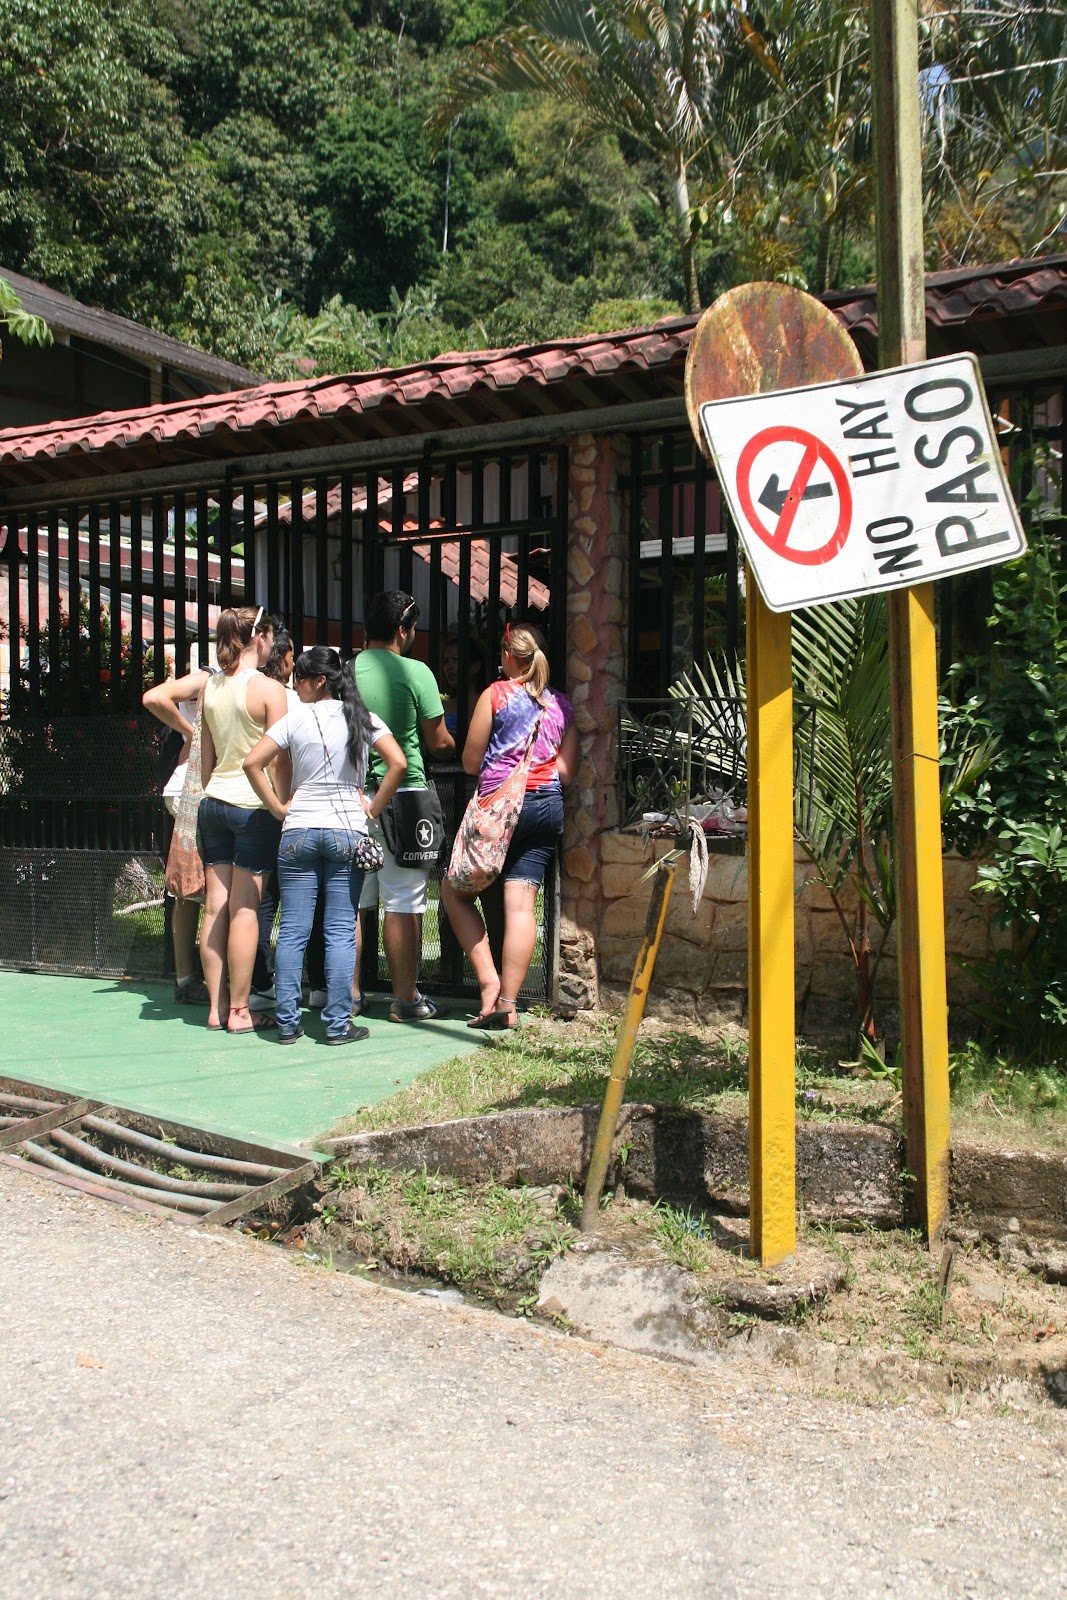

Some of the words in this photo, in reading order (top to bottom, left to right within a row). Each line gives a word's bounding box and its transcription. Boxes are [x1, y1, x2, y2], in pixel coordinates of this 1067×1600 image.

[835, 398, 900, 478] HAY
[904, 377, 1011, 557] PASO
[865, 515, 923, 575] NO
